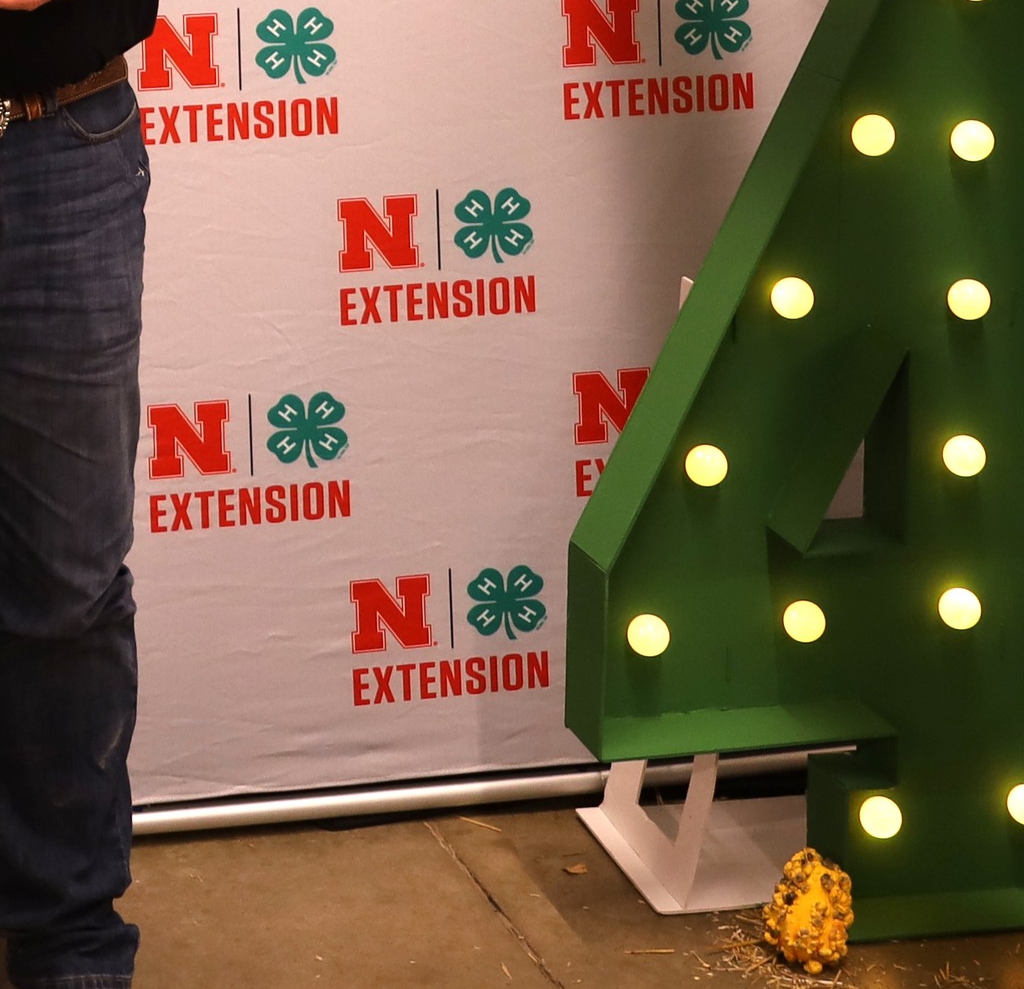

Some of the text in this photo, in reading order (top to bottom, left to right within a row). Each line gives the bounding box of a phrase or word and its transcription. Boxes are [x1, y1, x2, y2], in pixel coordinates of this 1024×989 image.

[133, 12, 220, 92] N
[139, 96, 339, 146] EXTENSION
[563, 72, 754, 121] EXTENSION
[337, 194, 421, 273] N
[339, 275, 536, 326] EXTENSION
[147, 399, 233, 480] N
[573, 367, 650, 445] N
[149, 479, 351, 533] EXTENSION
[350, 574, 433, 655] N
[352, 650, 550, 707] EXTENSION
